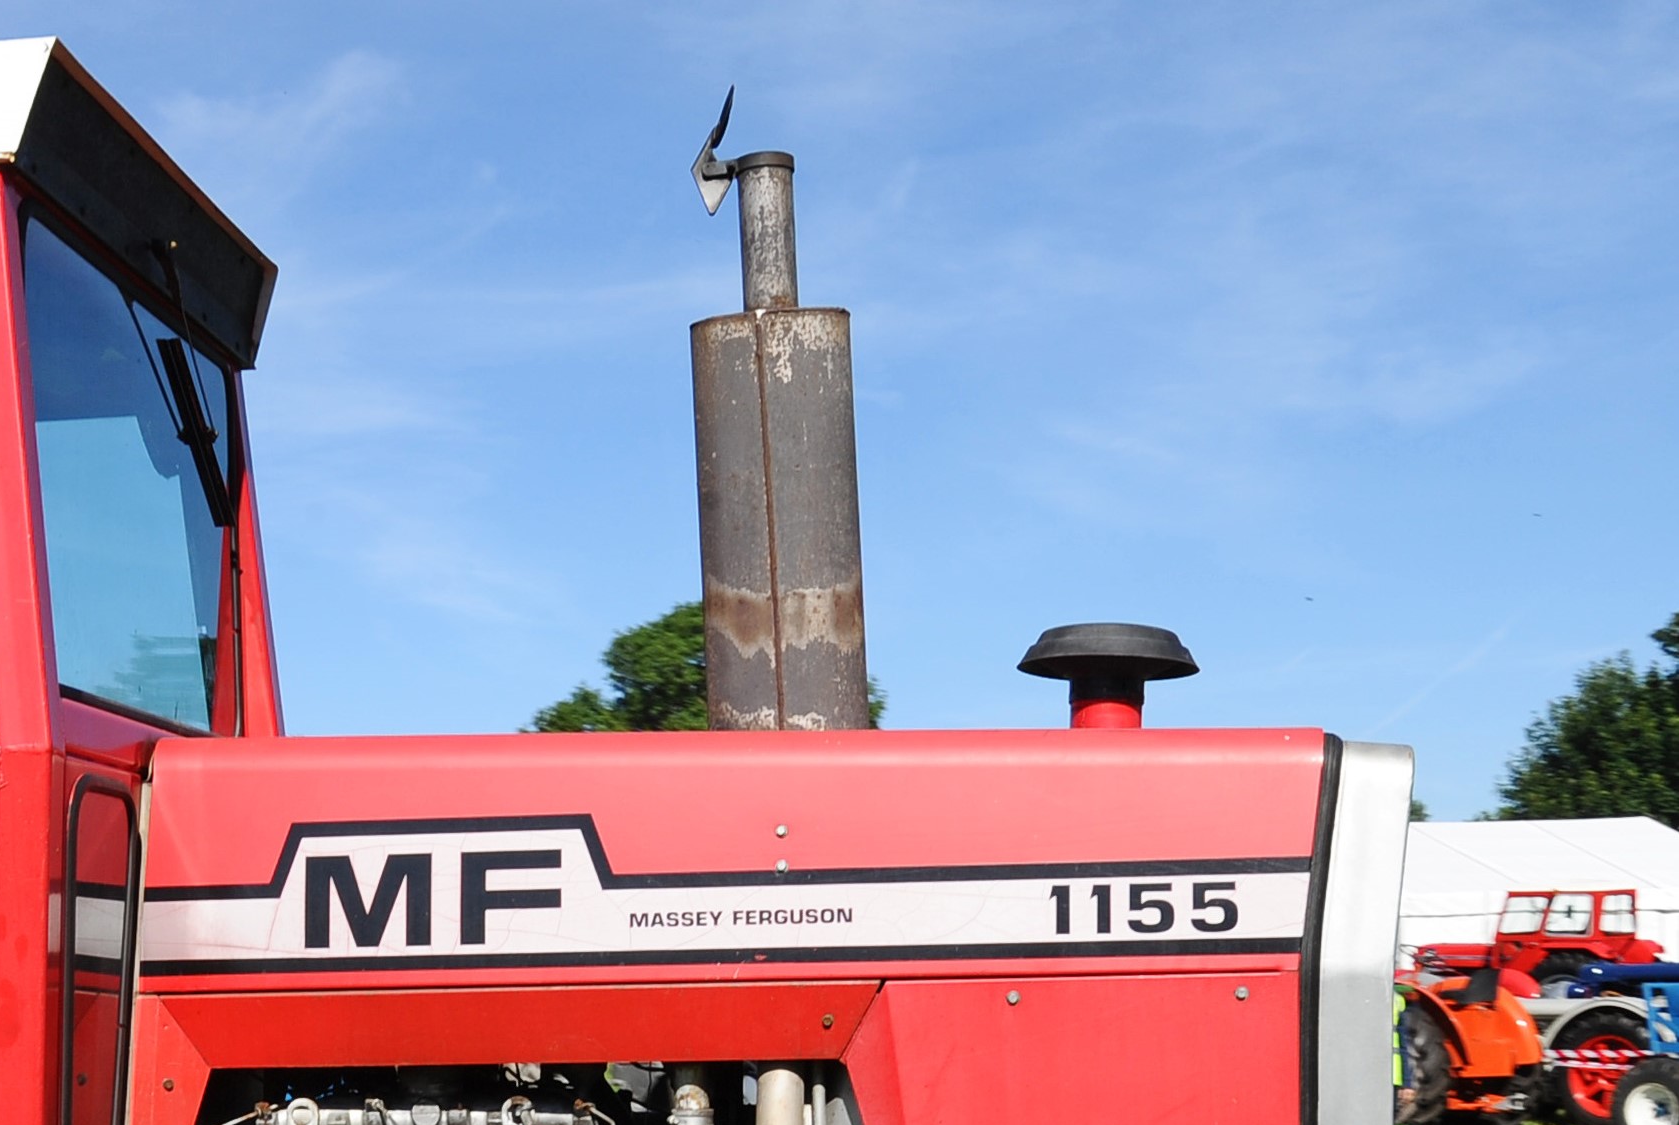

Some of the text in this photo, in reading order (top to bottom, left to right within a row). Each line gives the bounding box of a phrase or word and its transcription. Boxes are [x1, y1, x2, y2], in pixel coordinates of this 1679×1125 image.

[304, 848, 562, 949] MF
[629, 908, 854, 928] MASSEY FERGUSON
[1049, 881, 1239, 935] 1155
